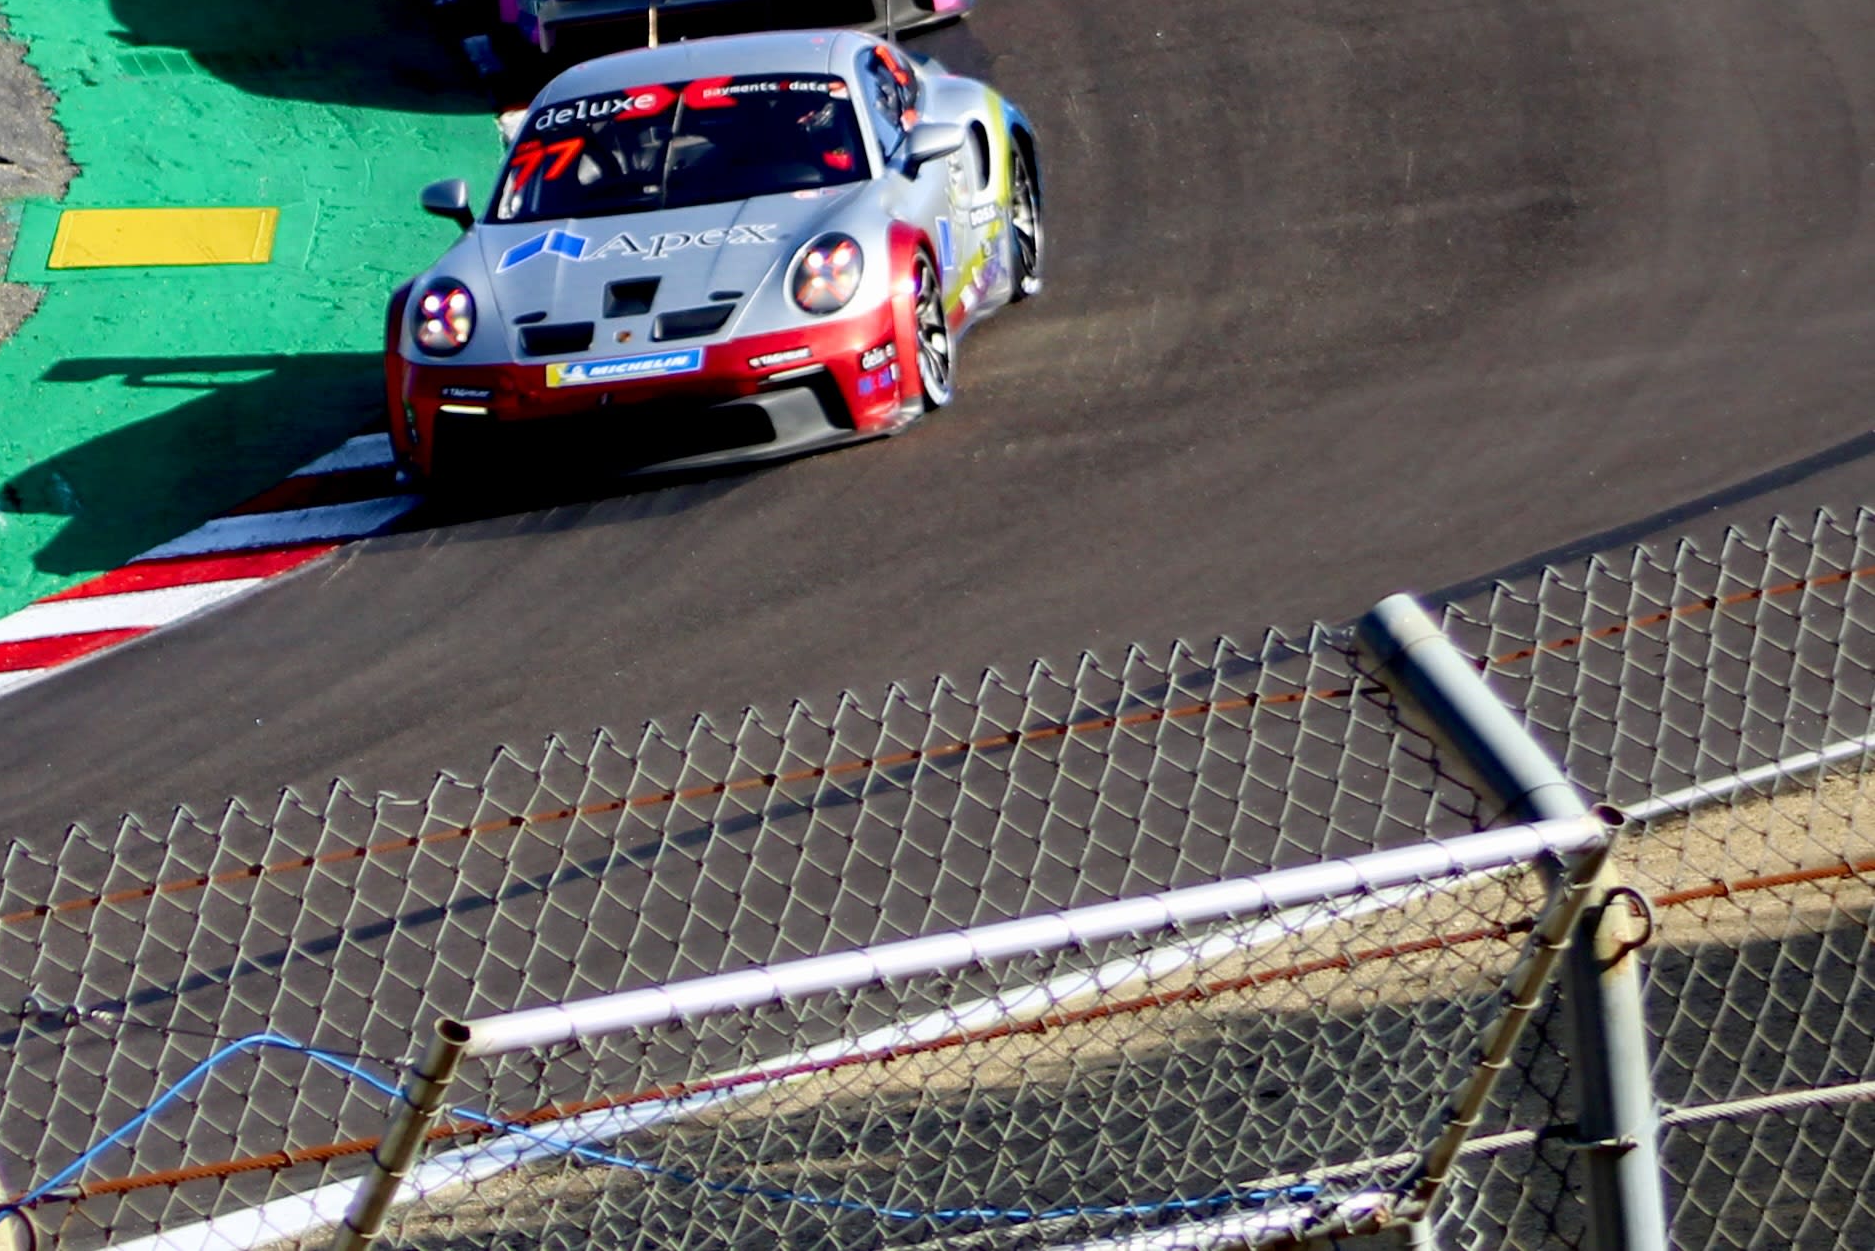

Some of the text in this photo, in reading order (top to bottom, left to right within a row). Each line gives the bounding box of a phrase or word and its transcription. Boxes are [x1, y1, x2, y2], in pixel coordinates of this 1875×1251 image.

[703, 80, 827, 99] payments data
[535, 93, 657, 131] deluxe
[510, 136, 585, 192] 77
[589, 354, 691, 377] MICHELIN
